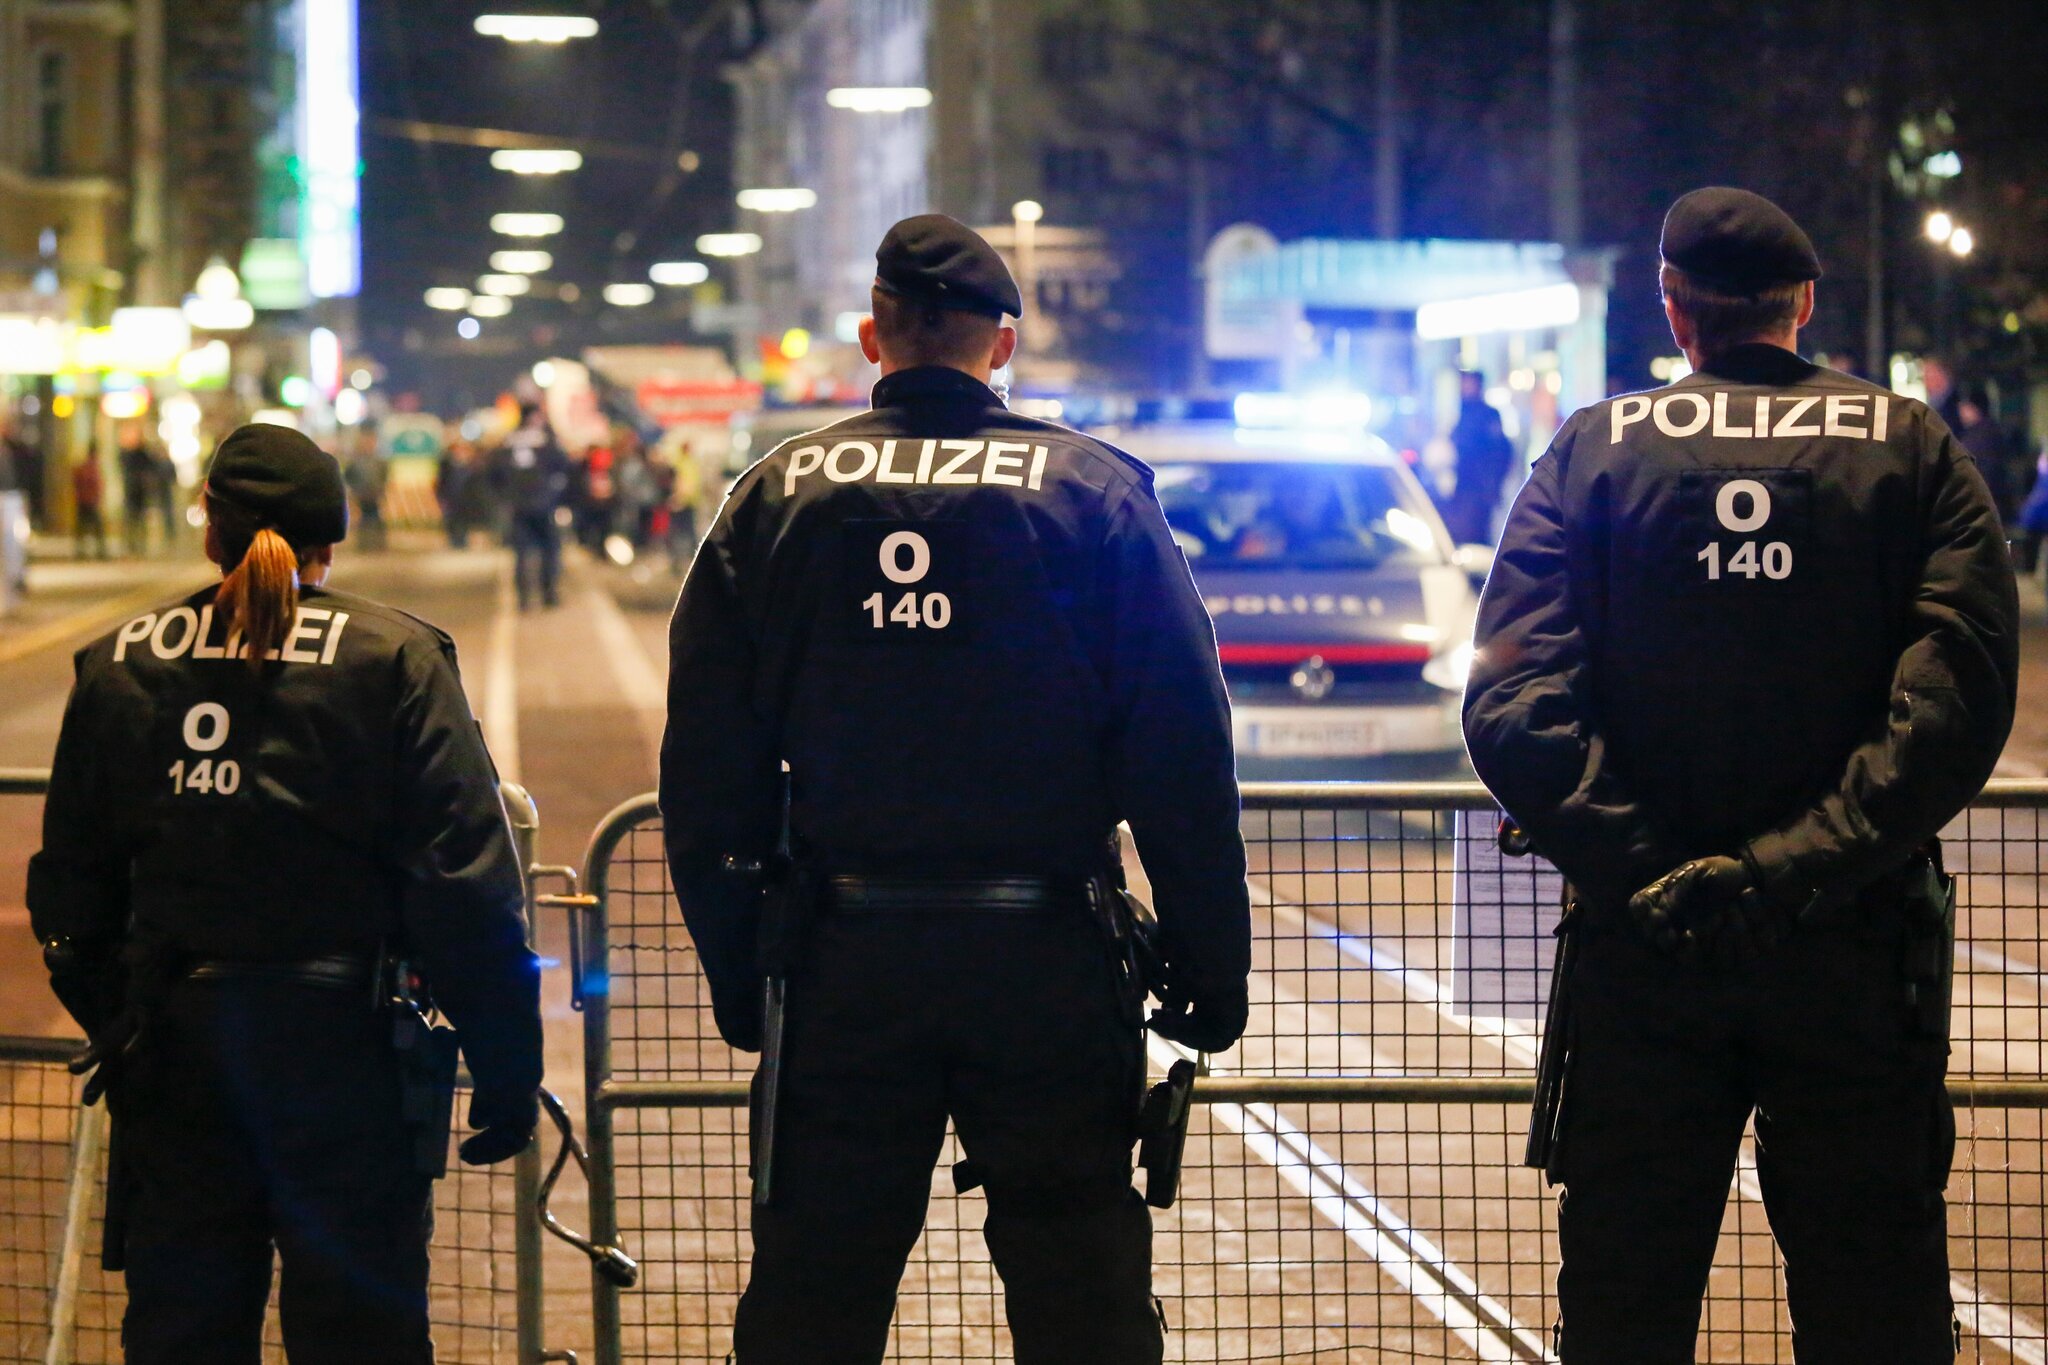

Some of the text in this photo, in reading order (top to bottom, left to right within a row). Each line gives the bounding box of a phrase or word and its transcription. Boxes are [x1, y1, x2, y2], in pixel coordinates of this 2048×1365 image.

[1609, 391, 1889, 445] POLIZEI
[784, 439, 1049, 497] POLIZEI
[1697, 541, 1793, 580] 140
[862, 592, 952, 629] 140
[168, 759, 240, 795] 140
